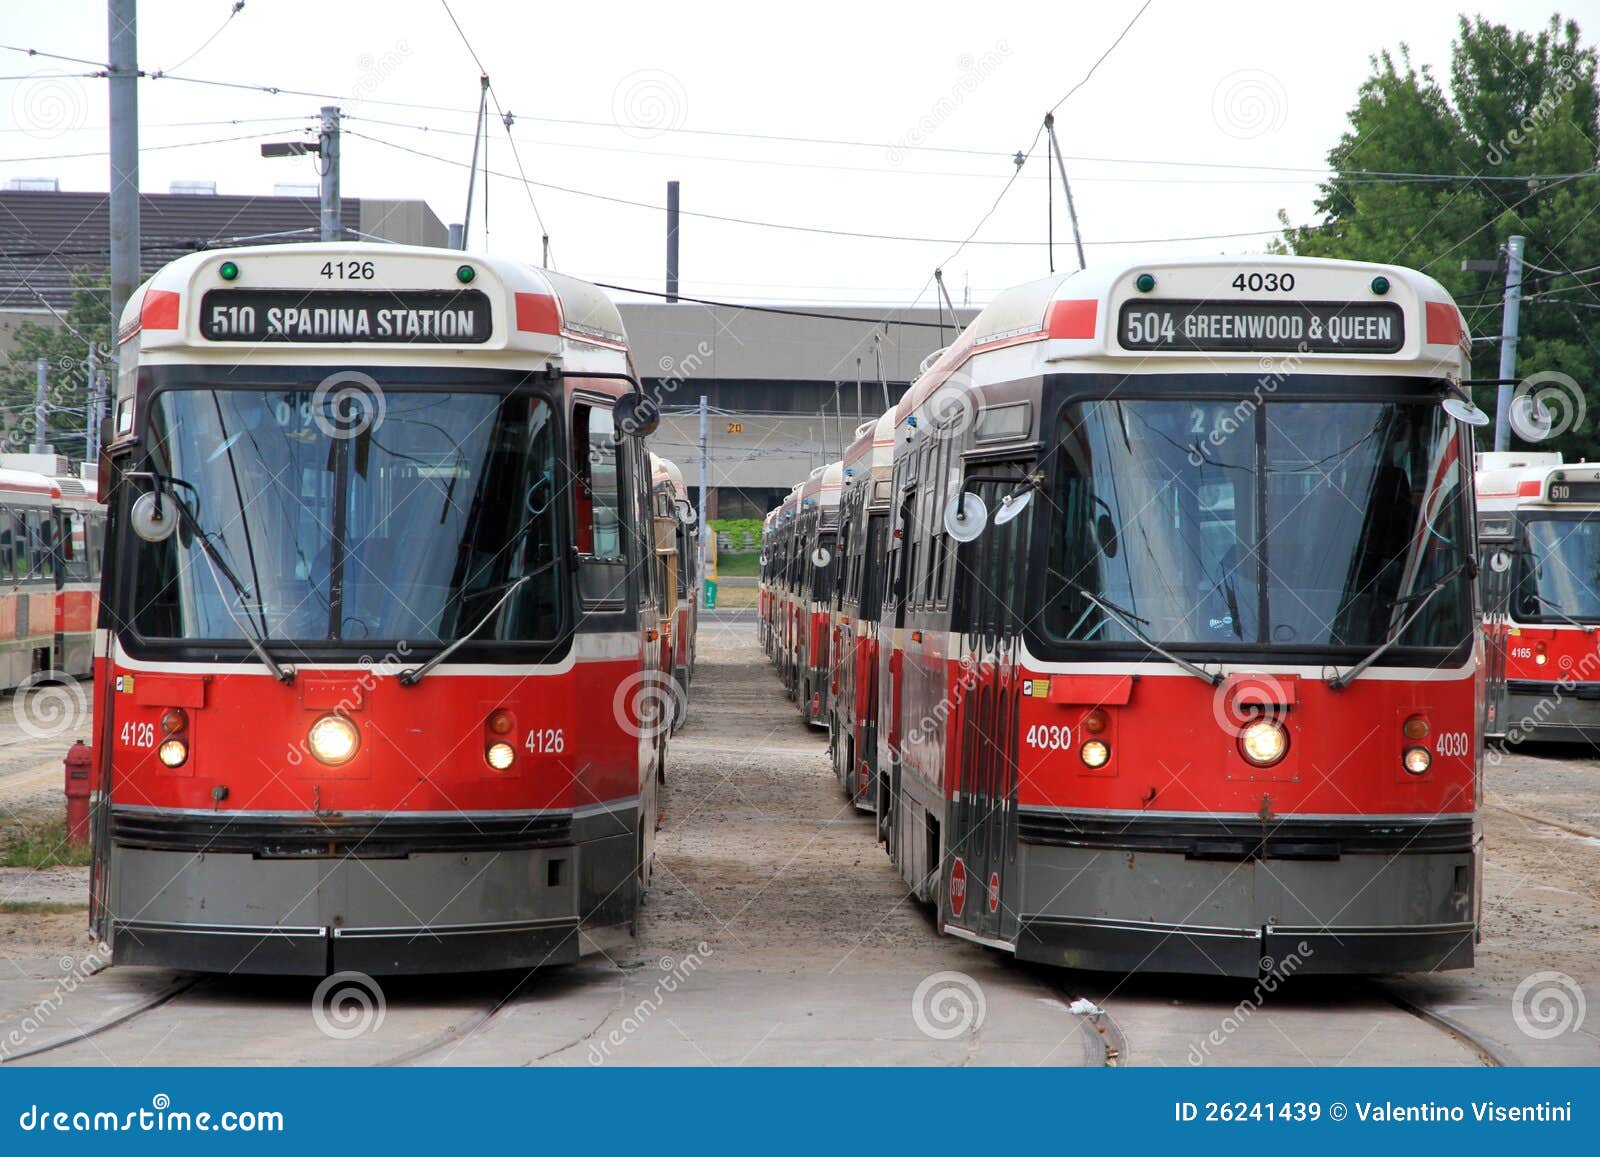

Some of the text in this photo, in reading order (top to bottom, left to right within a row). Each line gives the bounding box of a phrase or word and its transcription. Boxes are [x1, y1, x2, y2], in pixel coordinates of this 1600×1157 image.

[320, 261, 375, 280] 4126
[1232, 273, 1295, 292] 4030
[212, 306, 475, 337] 510 SPADINA STATION
[1128, 312, 1391, 344] 504 GREENWOOD & QUEEN
[1552, 486, 1569, 498] 510
[1511, 647, 1532, 659] 4165
[120, 721, 154, 749] 4126
[525, 728, 564, 753] 4126
[1026, 724, 1071, 750] 4030
[1436, 732, 1469, 757] 4030
[951, 877, 965, 897] STOP
